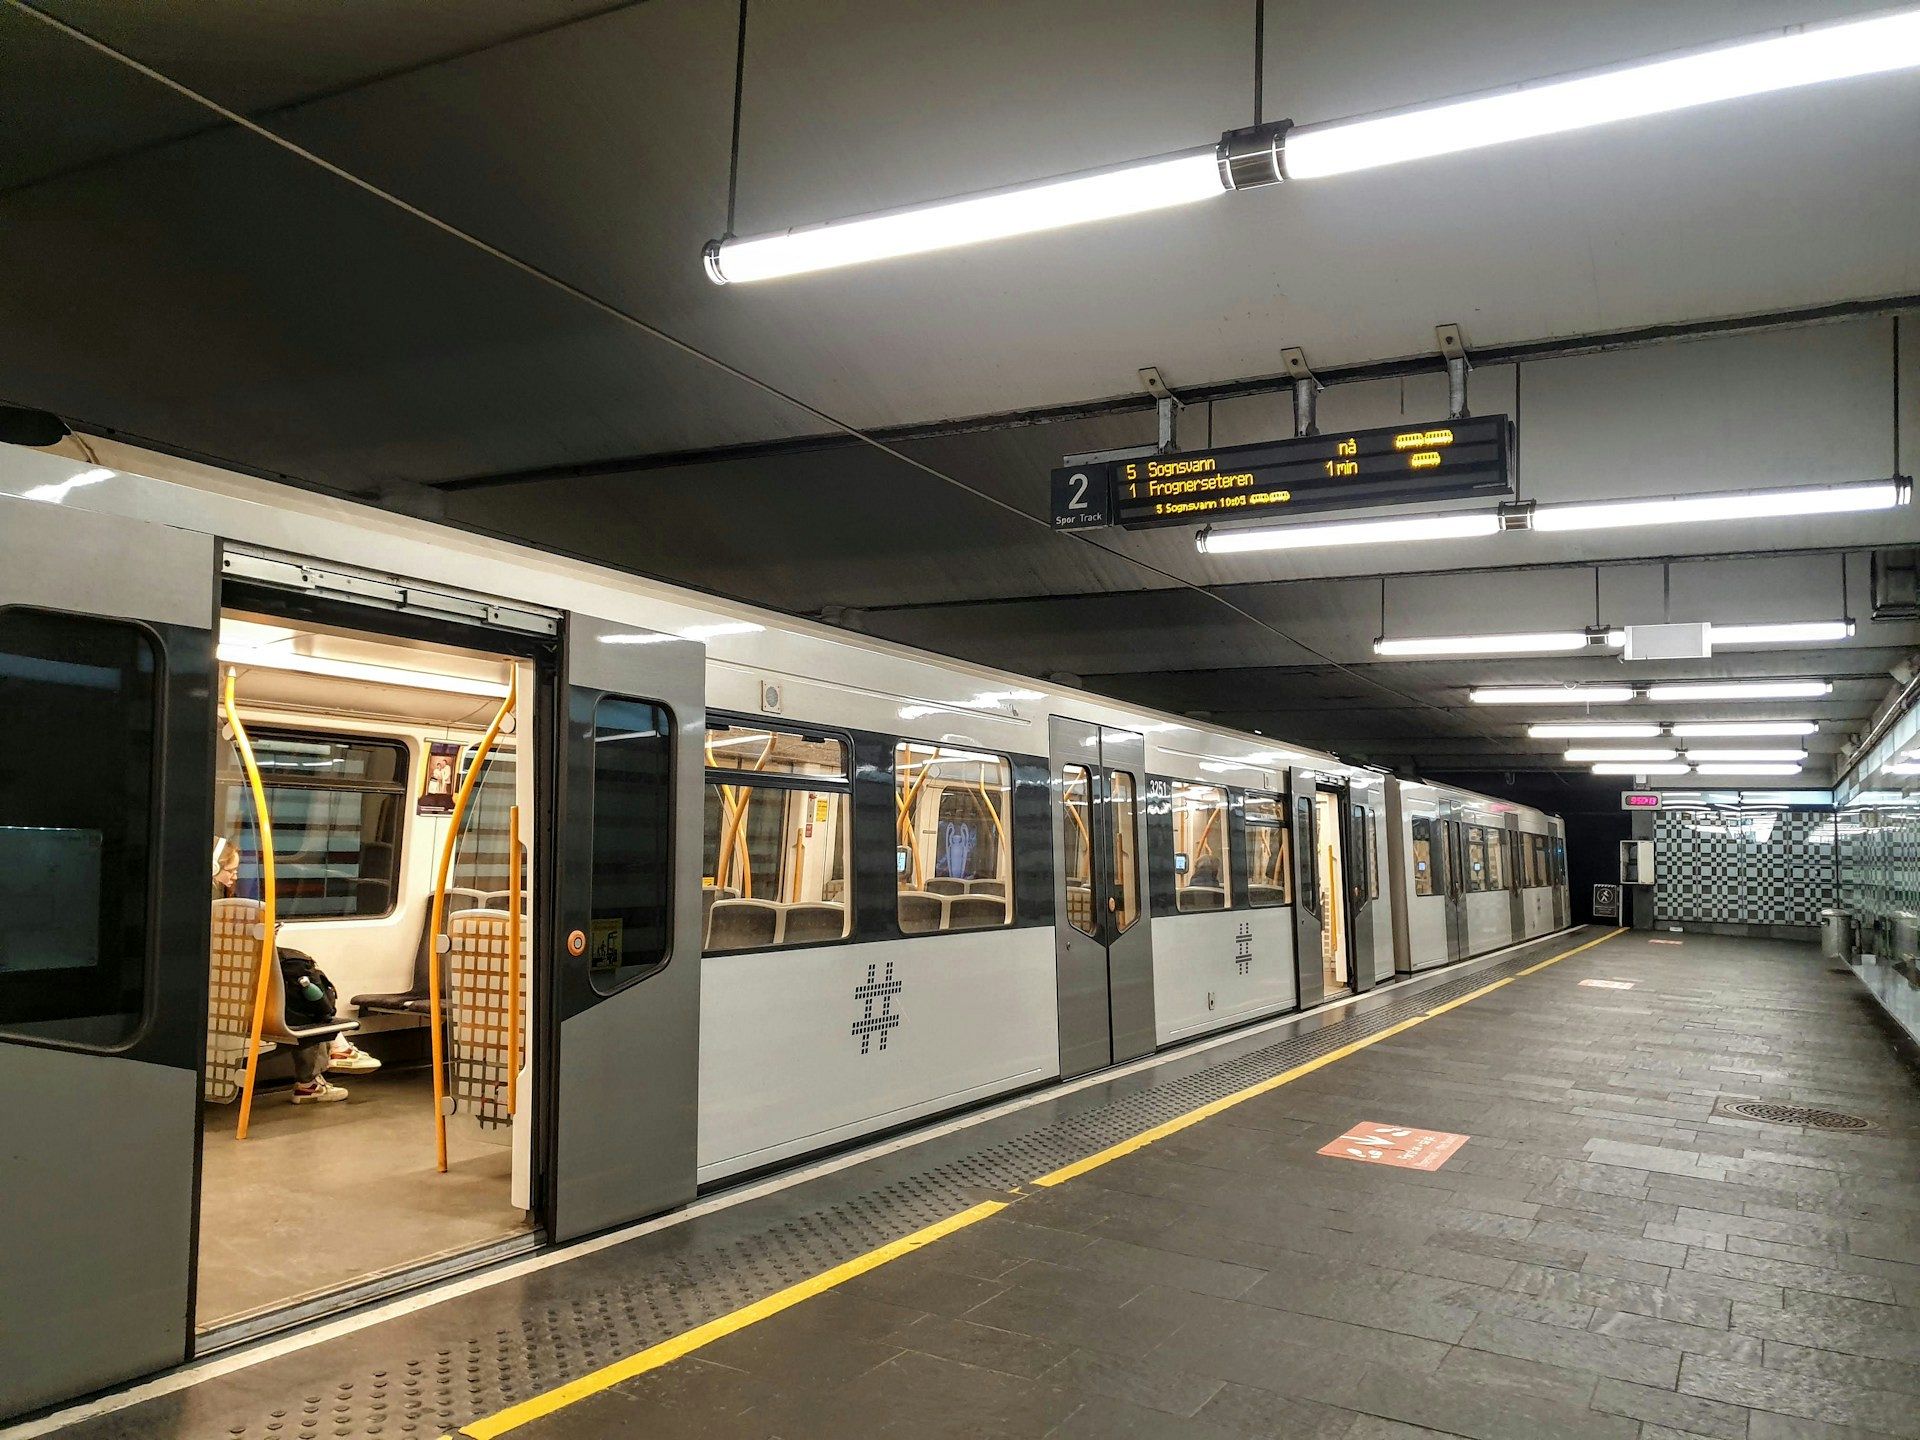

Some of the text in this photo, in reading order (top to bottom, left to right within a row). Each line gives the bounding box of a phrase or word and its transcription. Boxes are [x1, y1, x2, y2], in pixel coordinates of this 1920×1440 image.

[1126, 437, 1358, 480] 5 Sognsvann nå
[1068, 473, 1089, 510] 2
[1128, 482, 1137, 499] 1
[1149, 472, 1254, 497] Frognerseteren
[1166, 500, 1218, 514] Sognsvann
[1055, 512, 1103, 526] Spor Track
[1149, 779, 1167, 797] 3251
